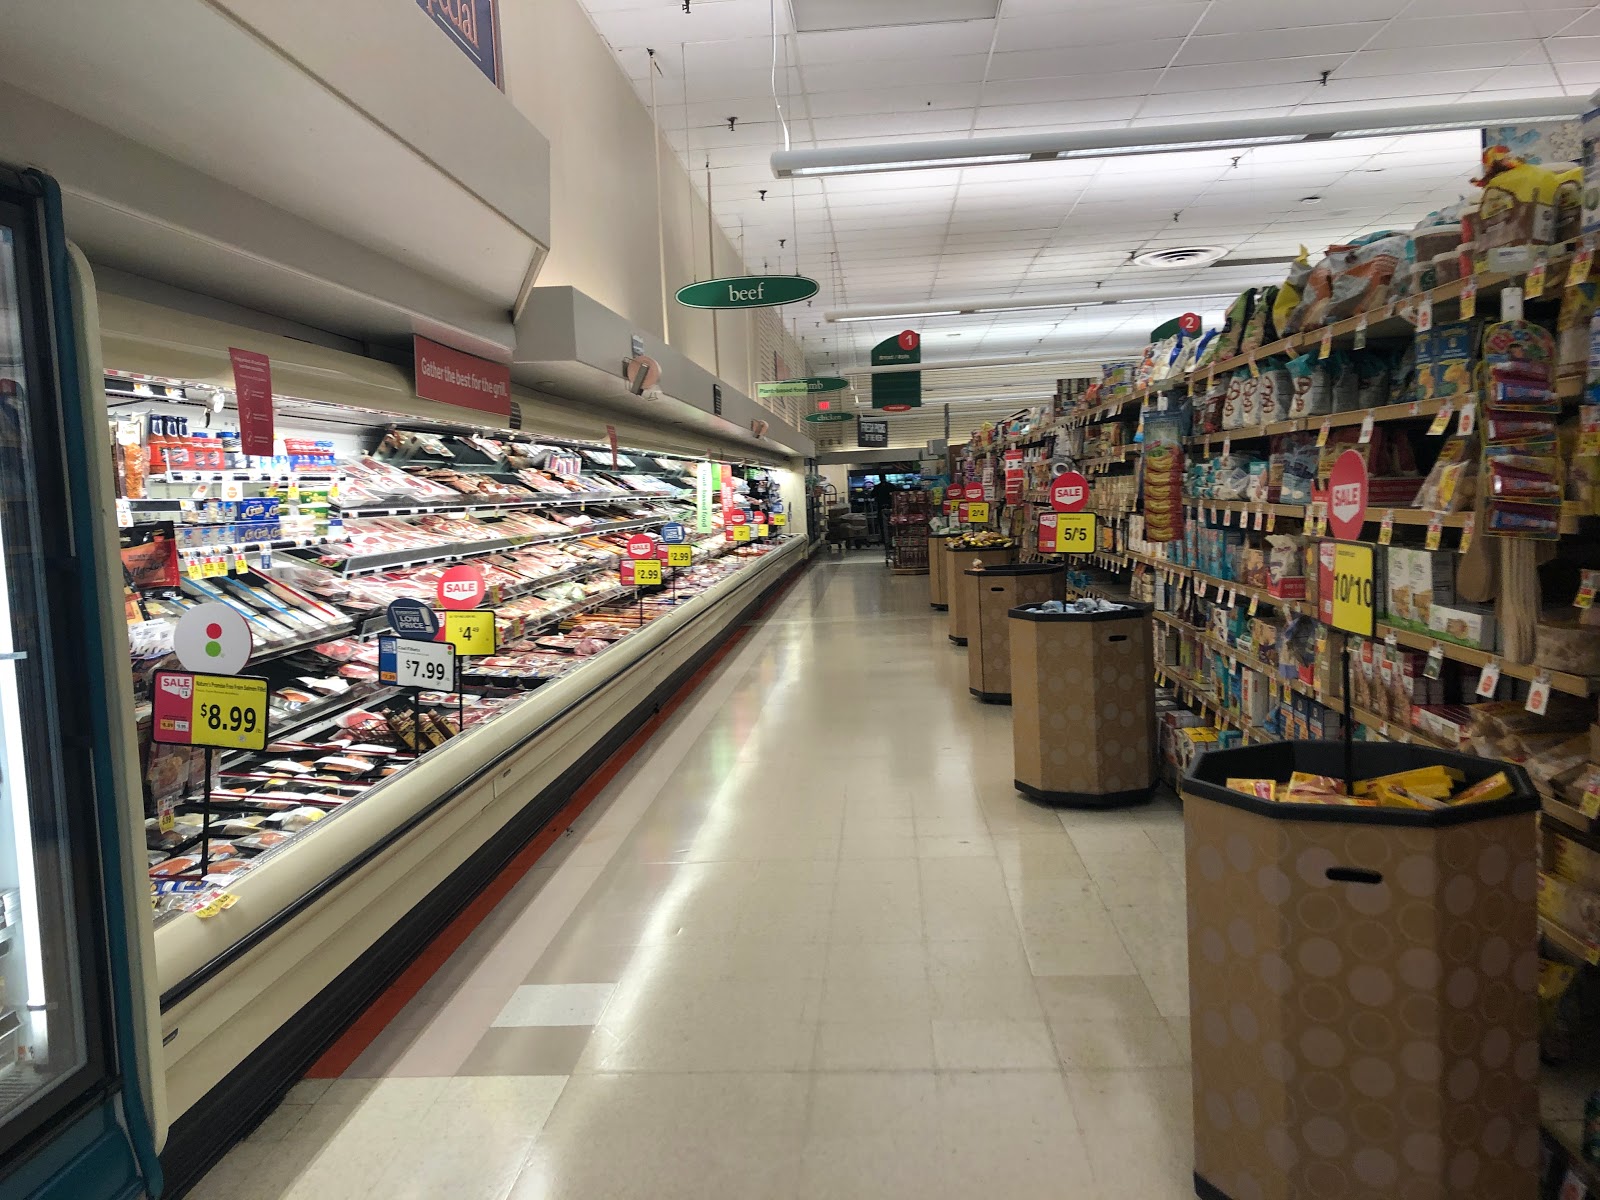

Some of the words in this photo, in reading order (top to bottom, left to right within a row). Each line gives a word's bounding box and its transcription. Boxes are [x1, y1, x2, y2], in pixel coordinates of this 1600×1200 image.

[728, 282, 765, 302] beef
[1185, 316, 1195, 329] 2
[905, 334, 913, 346] 1
[421, 357, 444, 380] Gather
[444, 366, 456, 384] the
[456, 369, 472, 388] best
[471, 374, 482, 391] for
[481, 378, 493, 394] the
[493, 381, 508, 398] grill.
[1057, 488, 1081, 498] SALE
[1335, 487, 1359, 507] SALE
[446, 583, 476, 593] SALE
[399, 621, 426, 629] PRICE
[406, 659, 445, 680] $7.99
[163, 678, 190, 687] SALE
[200, 702, 257, 733] $8.99
